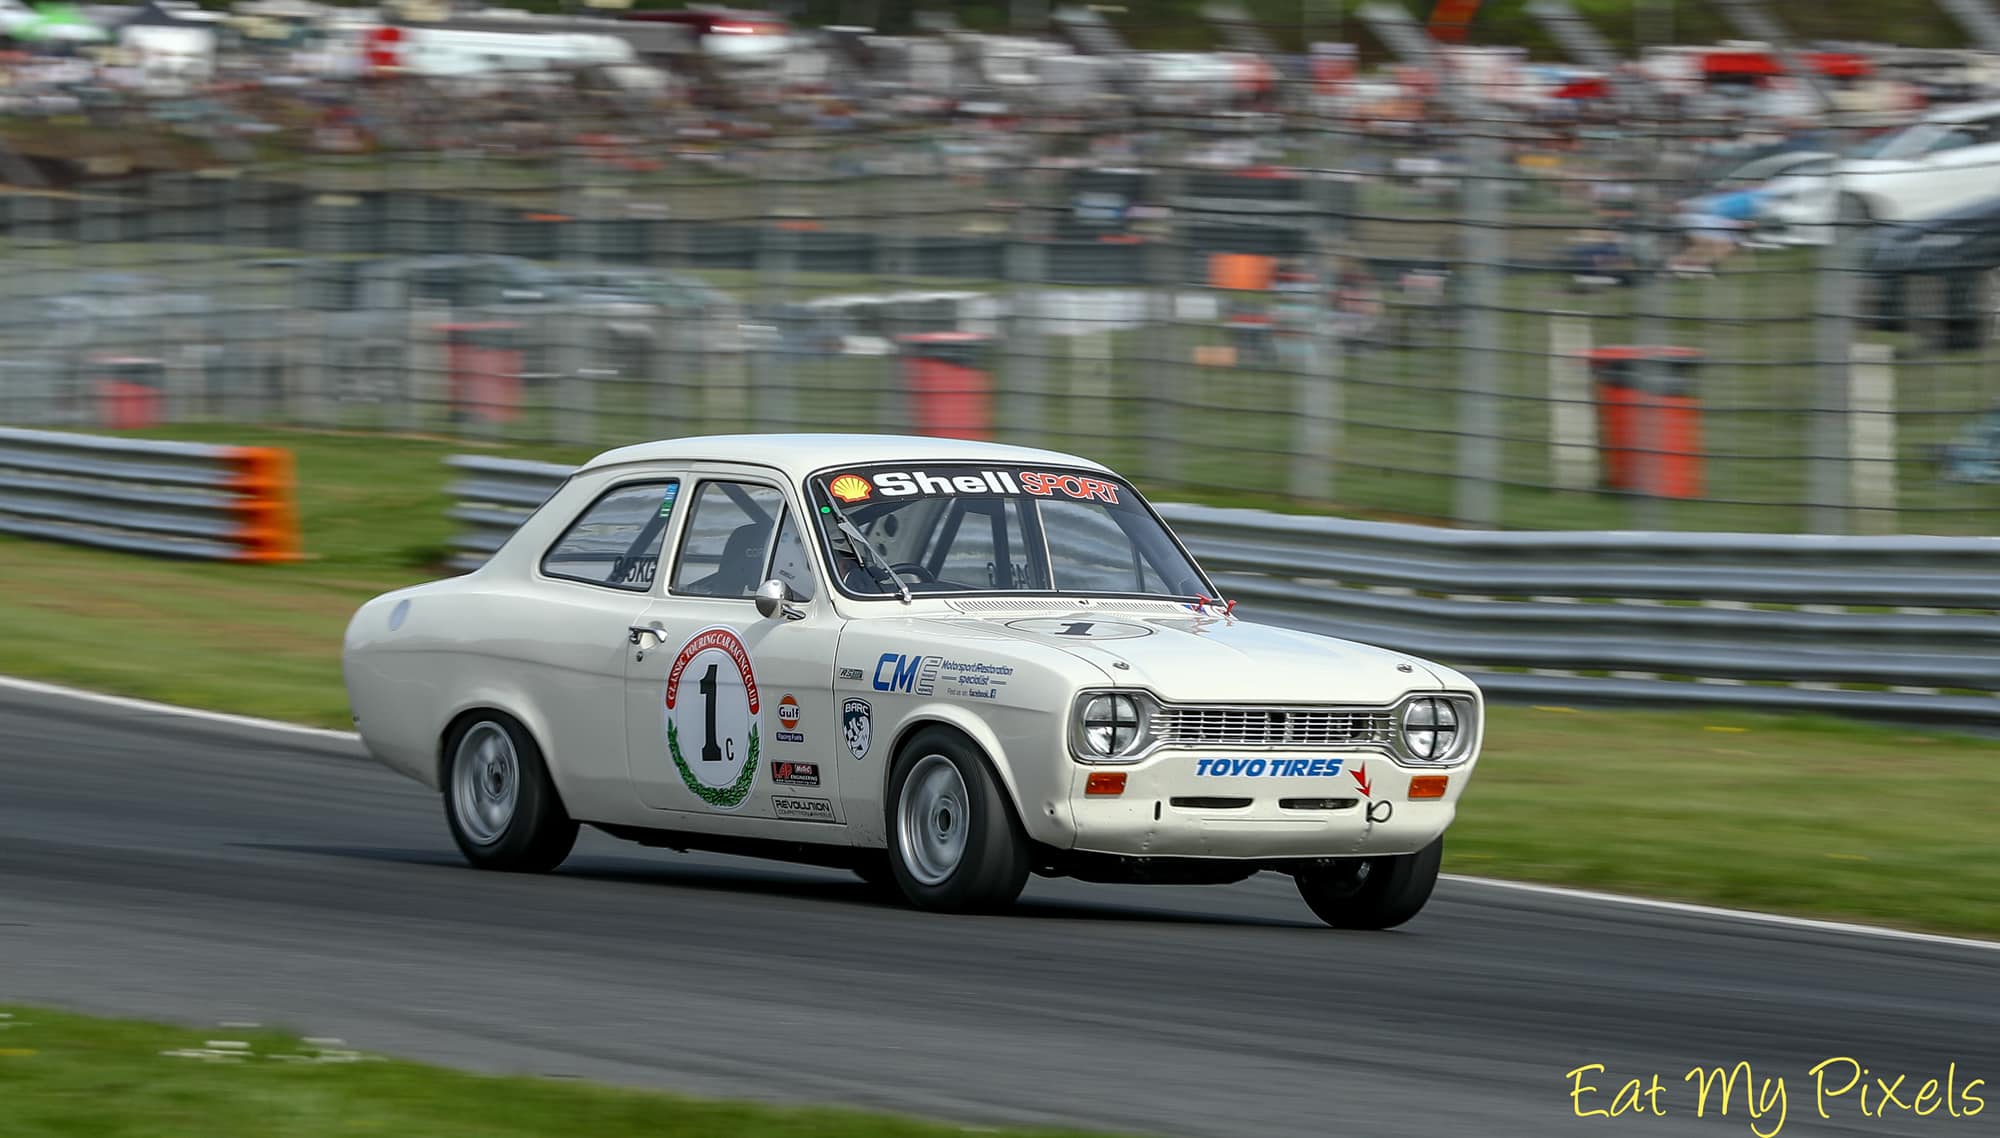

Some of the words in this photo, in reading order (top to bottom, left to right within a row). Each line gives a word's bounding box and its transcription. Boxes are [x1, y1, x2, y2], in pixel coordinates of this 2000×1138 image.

[872, 471, 1021, 496] Shell
[1019, 471, 1119, 504] SPORT
[1054, 622, 1095, 636] 1
[668, 655, 687, 700] CLASSIC
[685, 634, 717, 658] TOURING
[716, 633, 732, 649] CAR
[729, 642, 750, 675] RACING
[745, 674, 758, 706] CLUB
[872, 653, 943, 696] CME
[958, 675, 989, 686] specialist
[699, 664, 722, 761] 1
[778, 706, 800, 719] Gulf
[845, 702, 869, 716] BARC
[1197, 759, 1268, 776] TOYO
[1269, 759, 1343, 776] TIRES
[775, 800, 830, 812] REVOLUTION
